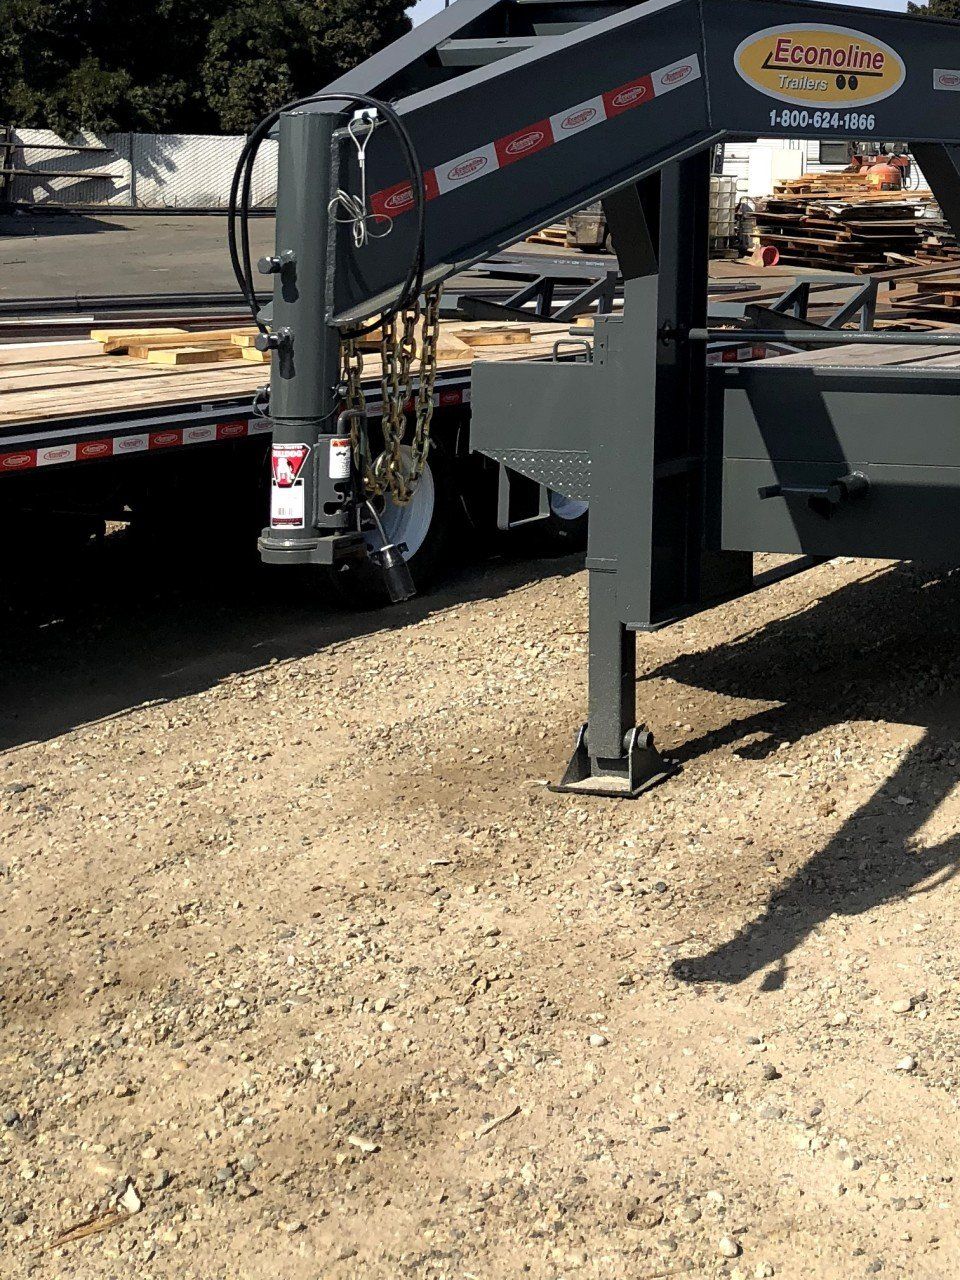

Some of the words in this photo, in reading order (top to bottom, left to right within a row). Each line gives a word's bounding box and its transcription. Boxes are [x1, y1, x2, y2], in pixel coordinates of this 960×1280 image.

[774, 38, 885, 70] Econoline
[779, 74, 828, 91] Trailers
[769, 109, 875, 131] 1-800-624-1866
